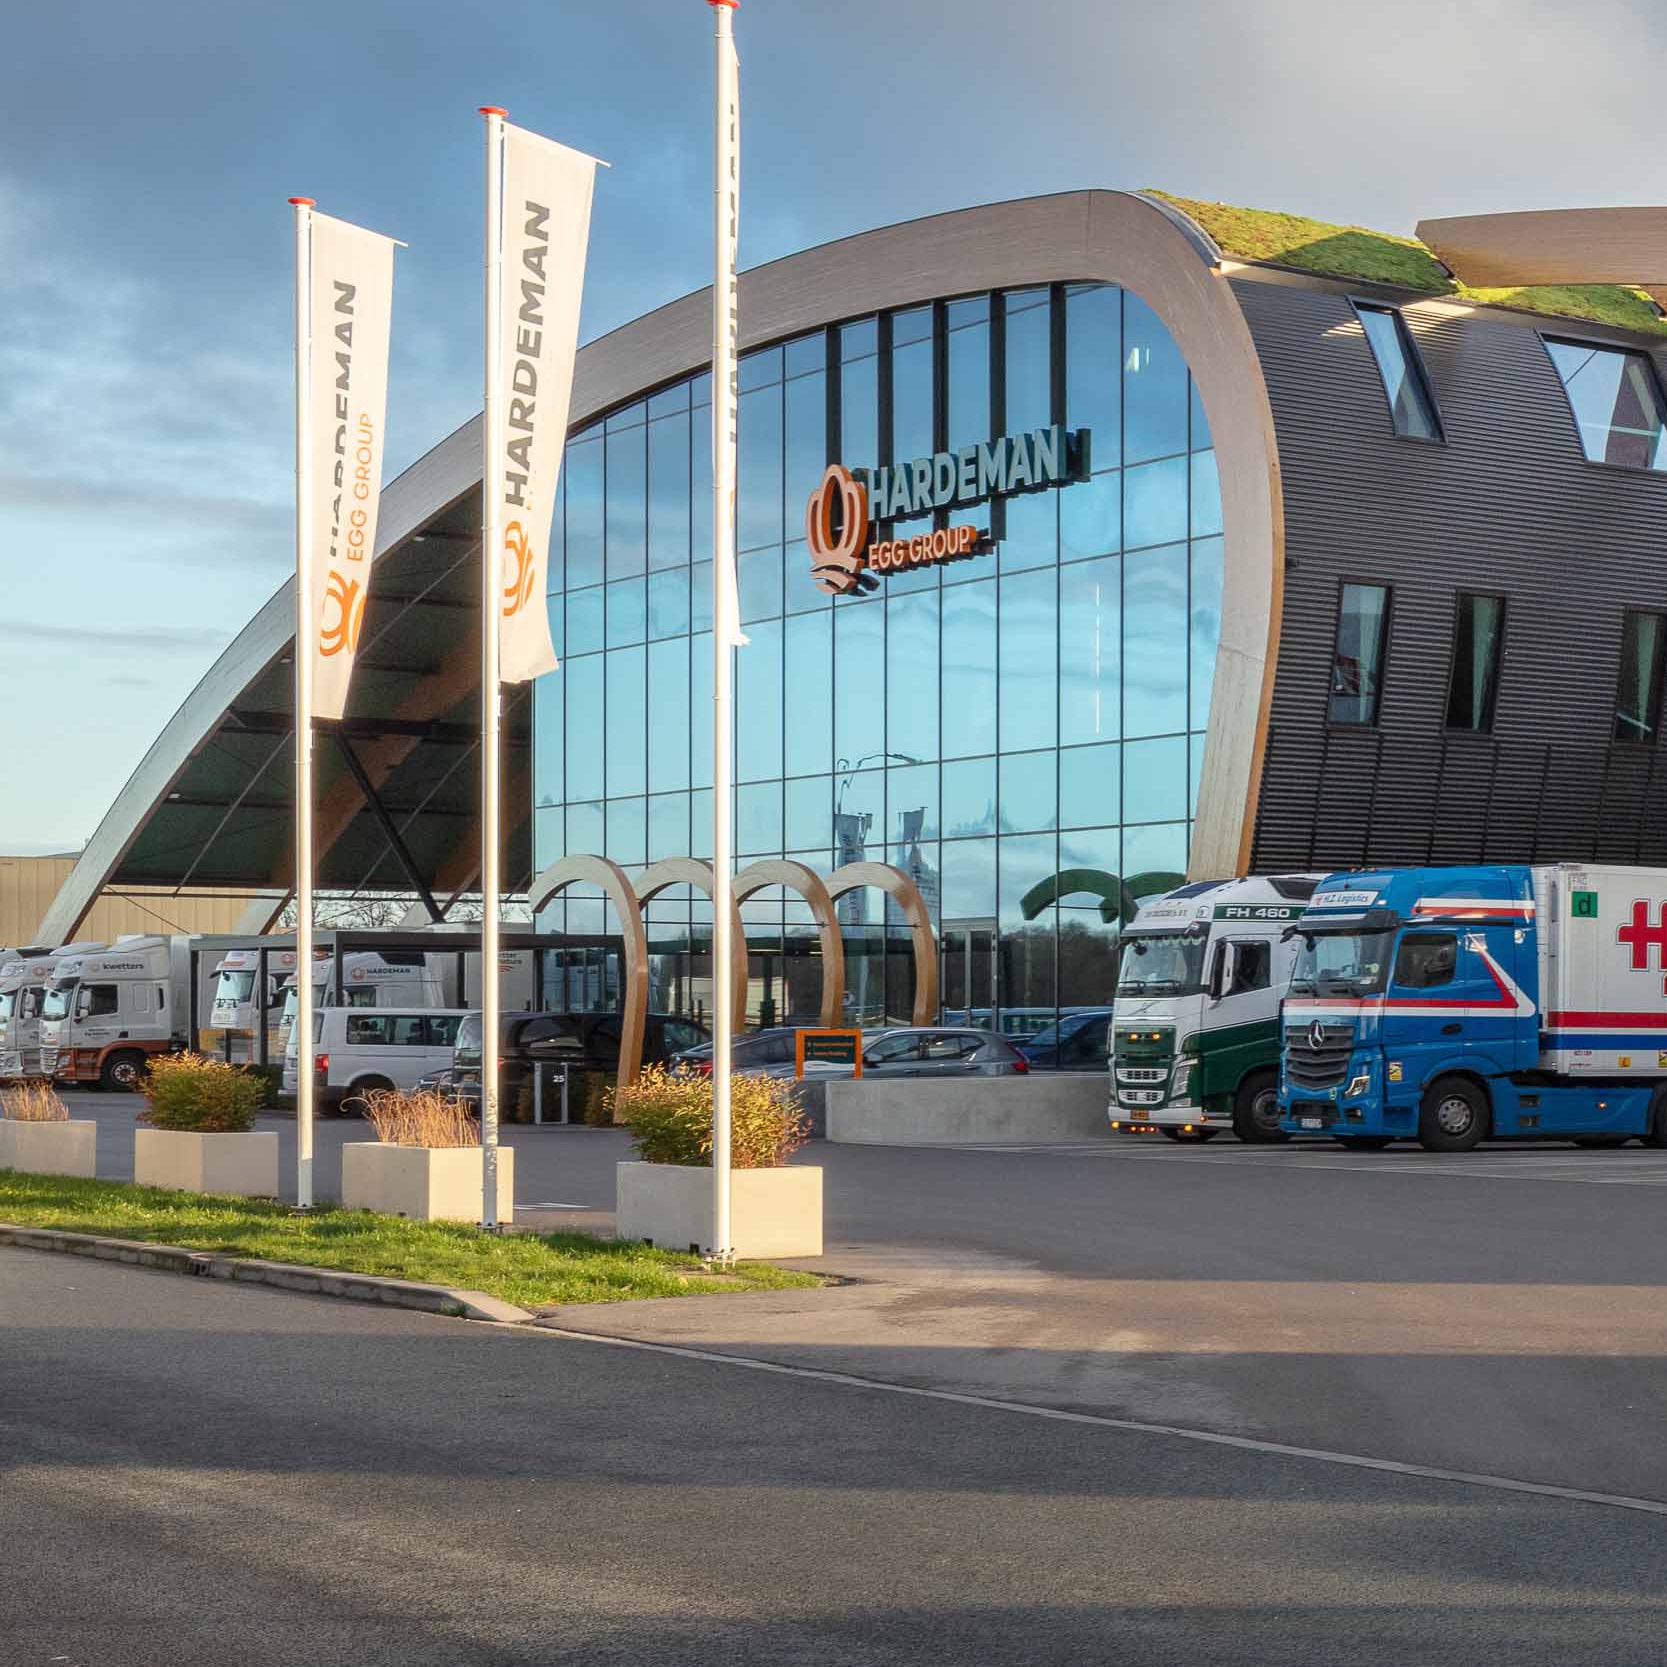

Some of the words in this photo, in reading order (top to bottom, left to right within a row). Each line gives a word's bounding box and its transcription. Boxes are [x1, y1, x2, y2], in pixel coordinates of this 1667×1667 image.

[505, 200, 550, 508] HARDEMAN
[352, 412, 374, 501] GROUP
[868, 423, 1060, 522] HARDEMAN
[346, 510, 366, 562] EGG
[868, 541, 904, 570] EGG
[908, 524, 971, 561] GROUP
[1226, 907, 1250, 918] FH
[1255, 907, 1291, 918] 460
[1578, 894, 1591, 915] d
[102, 962, 145, 971] kwetters
[366, 966, 412, 975] HARDEMAN
[552, 1075, 565, 1083] 25
